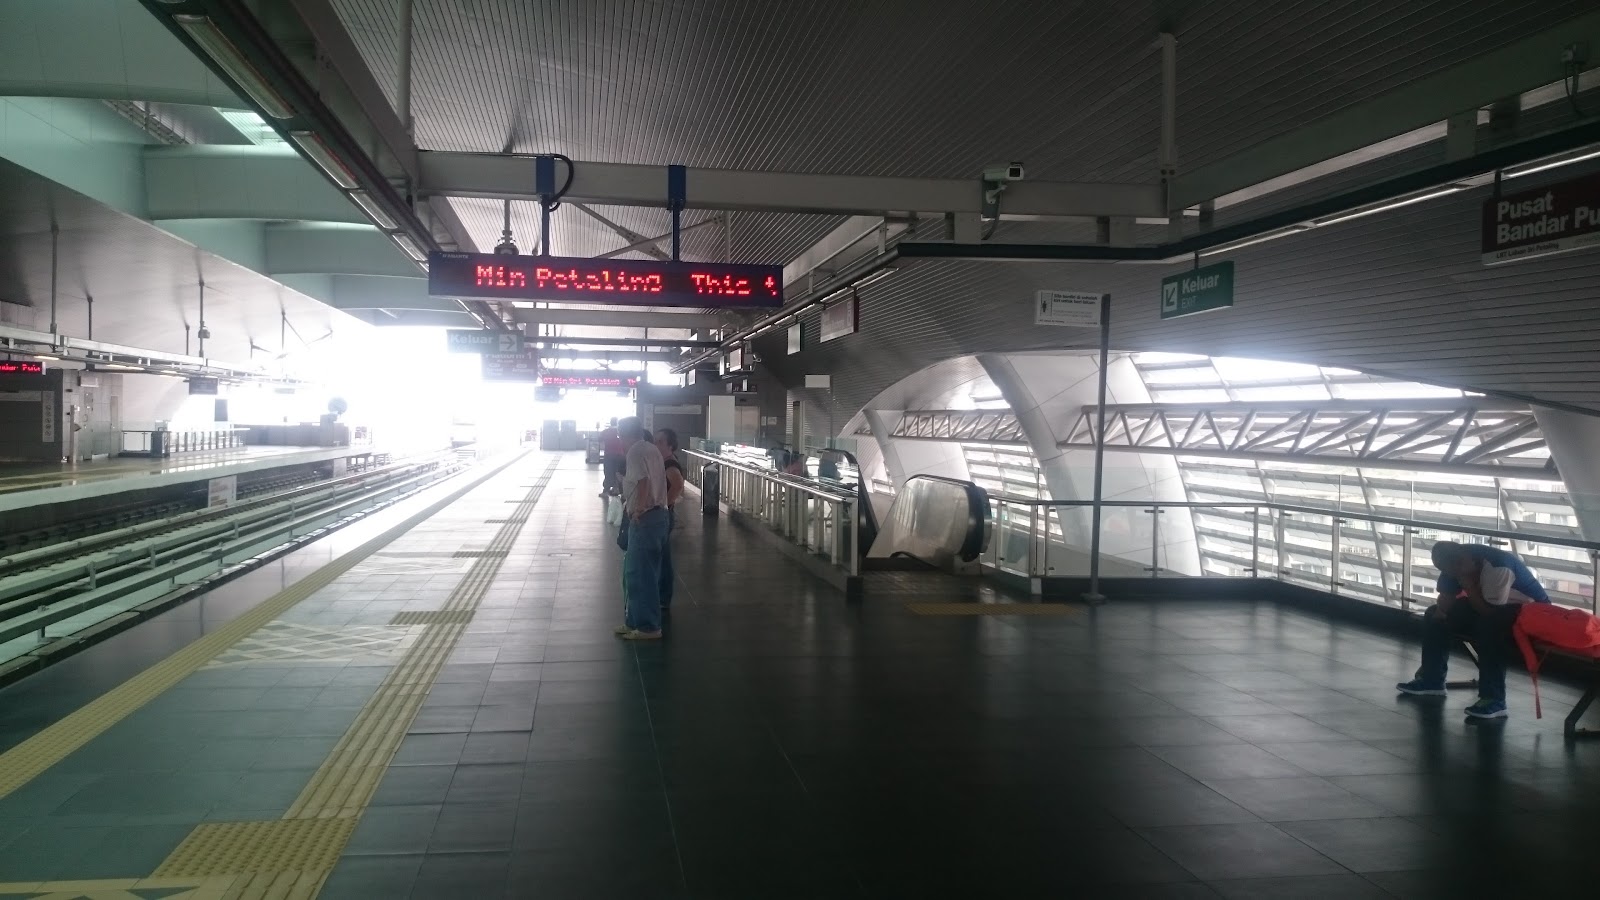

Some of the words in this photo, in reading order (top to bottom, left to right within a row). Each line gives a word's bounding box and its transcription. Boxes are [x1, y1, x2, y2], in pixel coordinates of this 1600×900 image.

[1497, 191, 1554, 222] Pusat
[1497, 214, 1569, 244] Bandar
[1574, 206, 1600, 229] Pu
[477, 265, 525, 287] Min
[536, 268, 662, 292] Petaling
[1182, 274, 1220, 295] Keluar
[451, 333, 494, 344] Keluar
